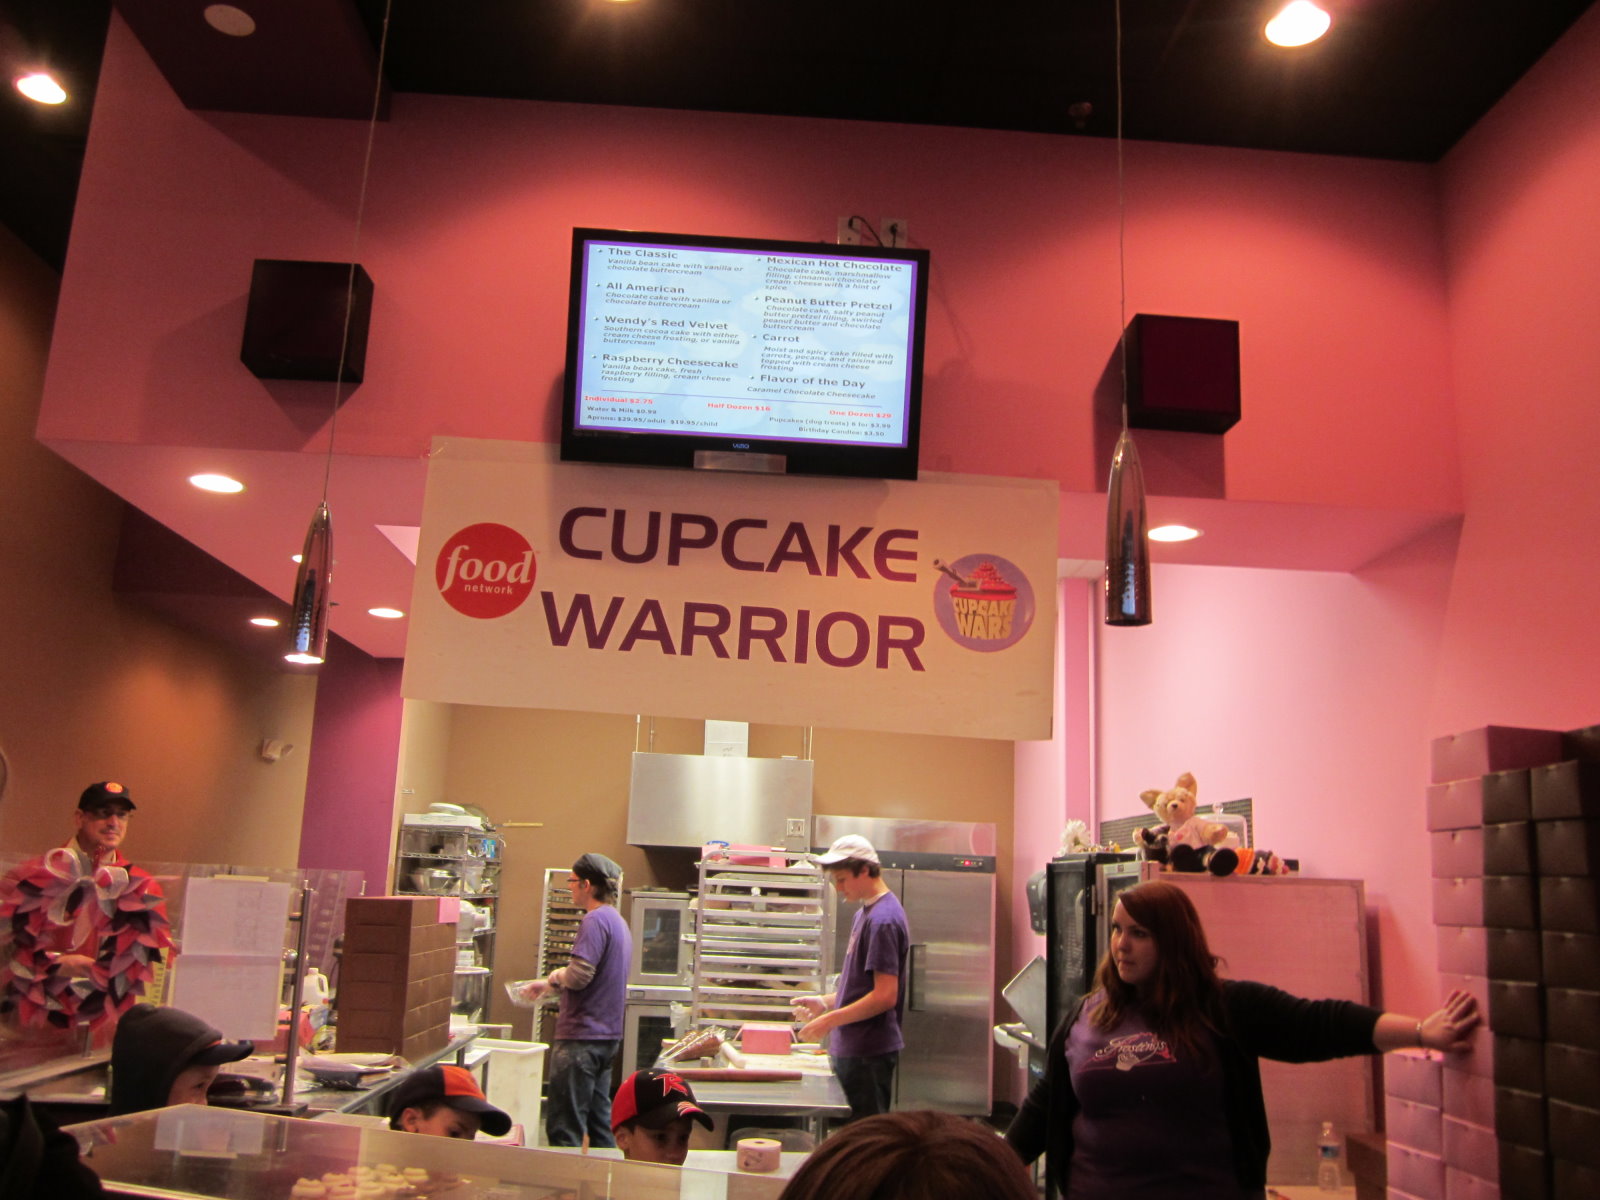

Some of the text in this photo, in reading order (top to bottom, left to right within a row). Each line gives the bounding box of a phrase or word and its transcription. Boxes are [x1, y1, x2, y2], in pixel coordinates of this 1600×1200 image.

[608, 248, 677, 258] The Classic
[767, 257, 815, 266] Mexican
[844, 262, 902, 272] Chocolate
[650, 267, 702, 276] buttercream
[835, 270, 891, 279] marshmallow
[837, 276, 878, 284] chocolate
[606, 282, 684, 293] All American
[606, 292, 648, 300] Chocolate
[648, 301, 700, 309] buttercream
[765, 296, 893, 310] Peanut Butter Pretzel
[766, 305, 808, 313] Chocolate
[834, 309, 853, 317] salty
[661, 319, 684, 327] Red
[689, 321, 728, 329] Velvet
[792, 313, 820, 321] pretzel
[852, 316, 883, 324] swirled
[604, 325, 642, 333] Southern
[763, 323, 815, 331] buttercream
[840, 322, 881, 330] chocolate
[763, 334, 800, 342] Carrot
[603, 354, 738, 368] Raspberry Cheesecake
[761, 358, 790, 366] topped
[840, 362, 870, 370] cheese
[760, 375, 798, 384] Flavor
[818, 378, 838, 386] the
[843, 380, 866, 389] Day
[784, 388, 825, 396] Chocolate
[827, 391, 876, 399] Cheesecake
[559, 506, 918, 583] CUPCAKE
[440, 545, 534, 593] food
[464, 584, 513, 595] network
[540, 591, 926, 672] WARRIOR
